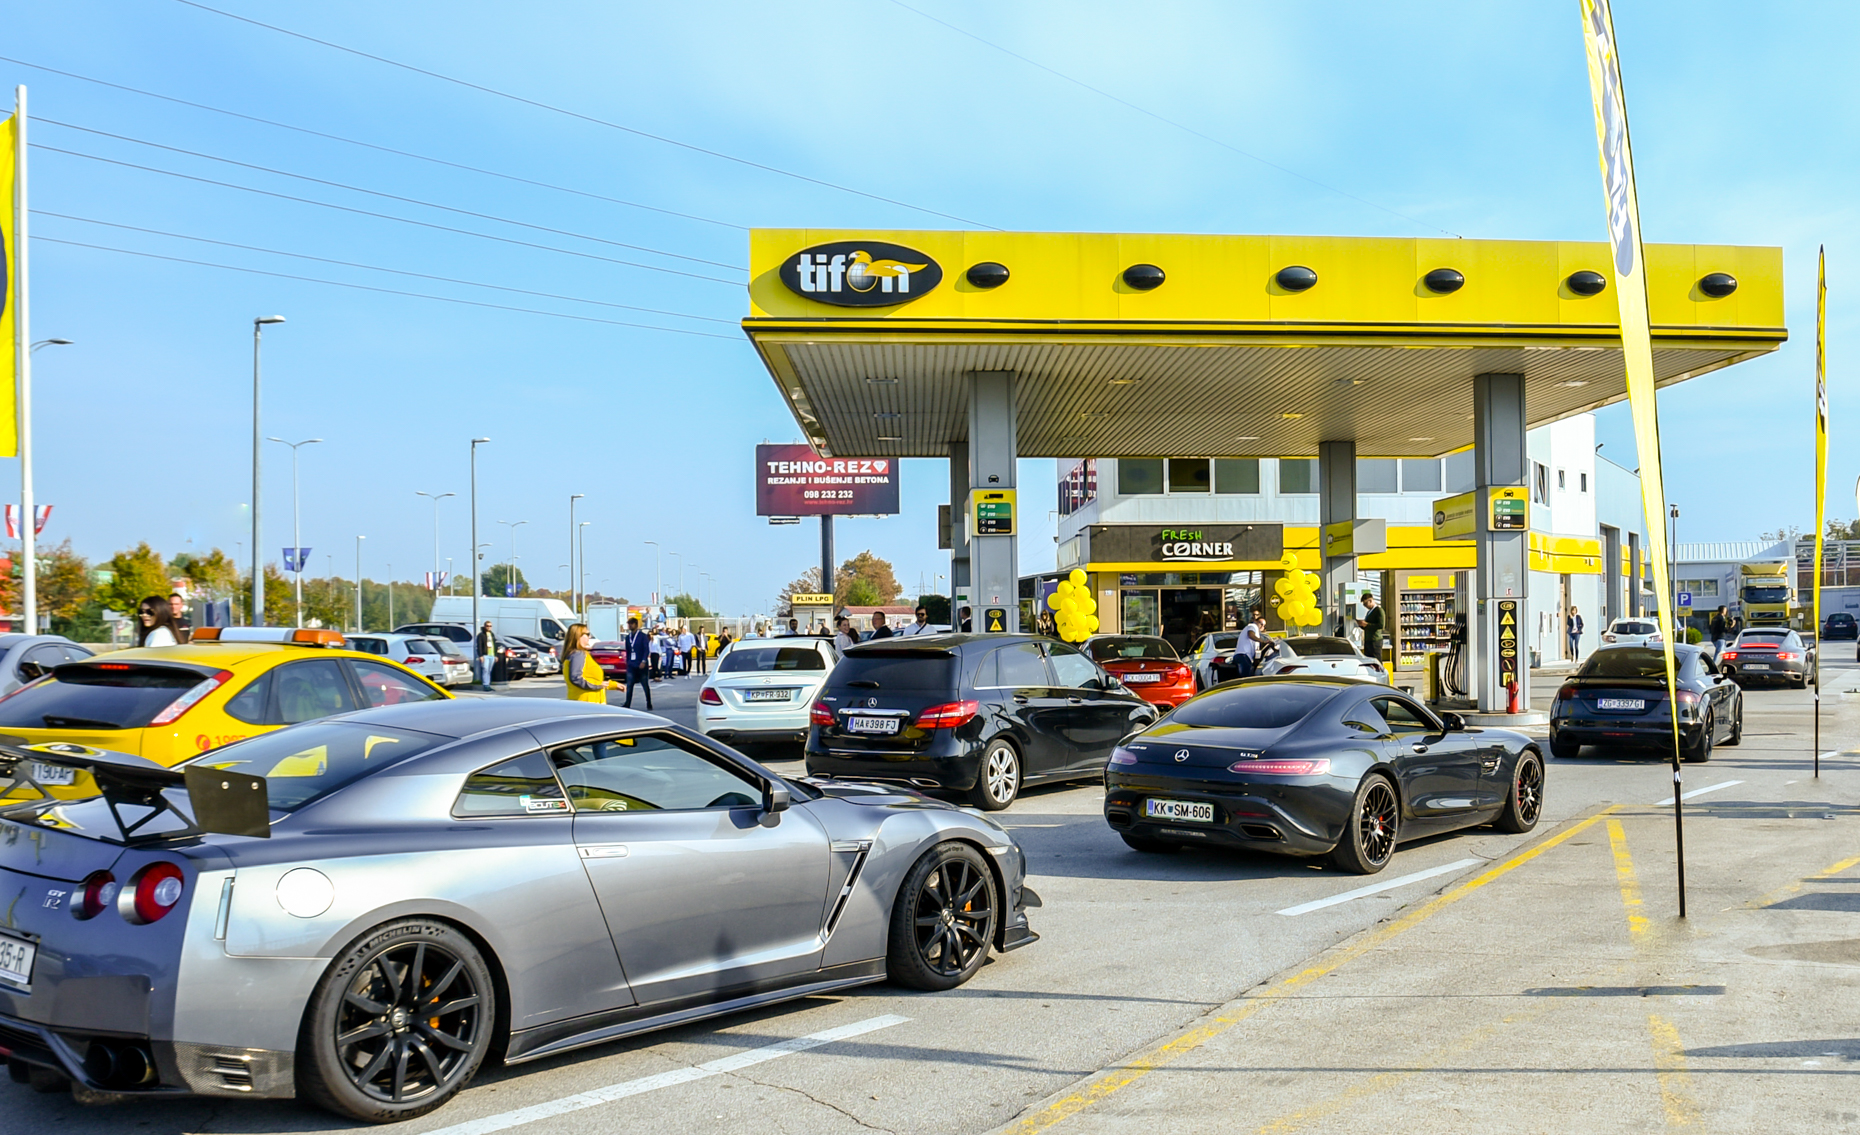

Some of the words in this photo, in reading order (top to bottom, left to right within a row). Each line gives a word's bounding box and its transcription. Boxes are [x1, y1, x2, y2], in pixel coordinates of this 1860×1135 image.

[797, 250, 909, 293] tifon
[767, 461, 872, 474] TEHNO-REZ
[813, 475, 853, 484] BUŠENJE
[854, 476, 889, 484] BETONA
[837, 490, 853, 498] 232
[1162, 529, 1202, 540] FRESH
[1162, 542, 1234, 556] CORNER
[1680, 593, 1689, 605] P
[751, 690, 760, 698] KP
[765, 690, 788, 698] FR-932
[1603, 699, 1612, 707] ZG
[854, 720, 864, 728] HA
[870, 720, 884, 729] 398
[886, 720, 896, 729] FJ
[1153, 803, 1167, 815] KK
[1174, 804, 1211, 819] SM-606
[47, 889, 66, 897] GT
[42, 896, 61, 910] R
[369, 925, 421, 949] MICHELIN
